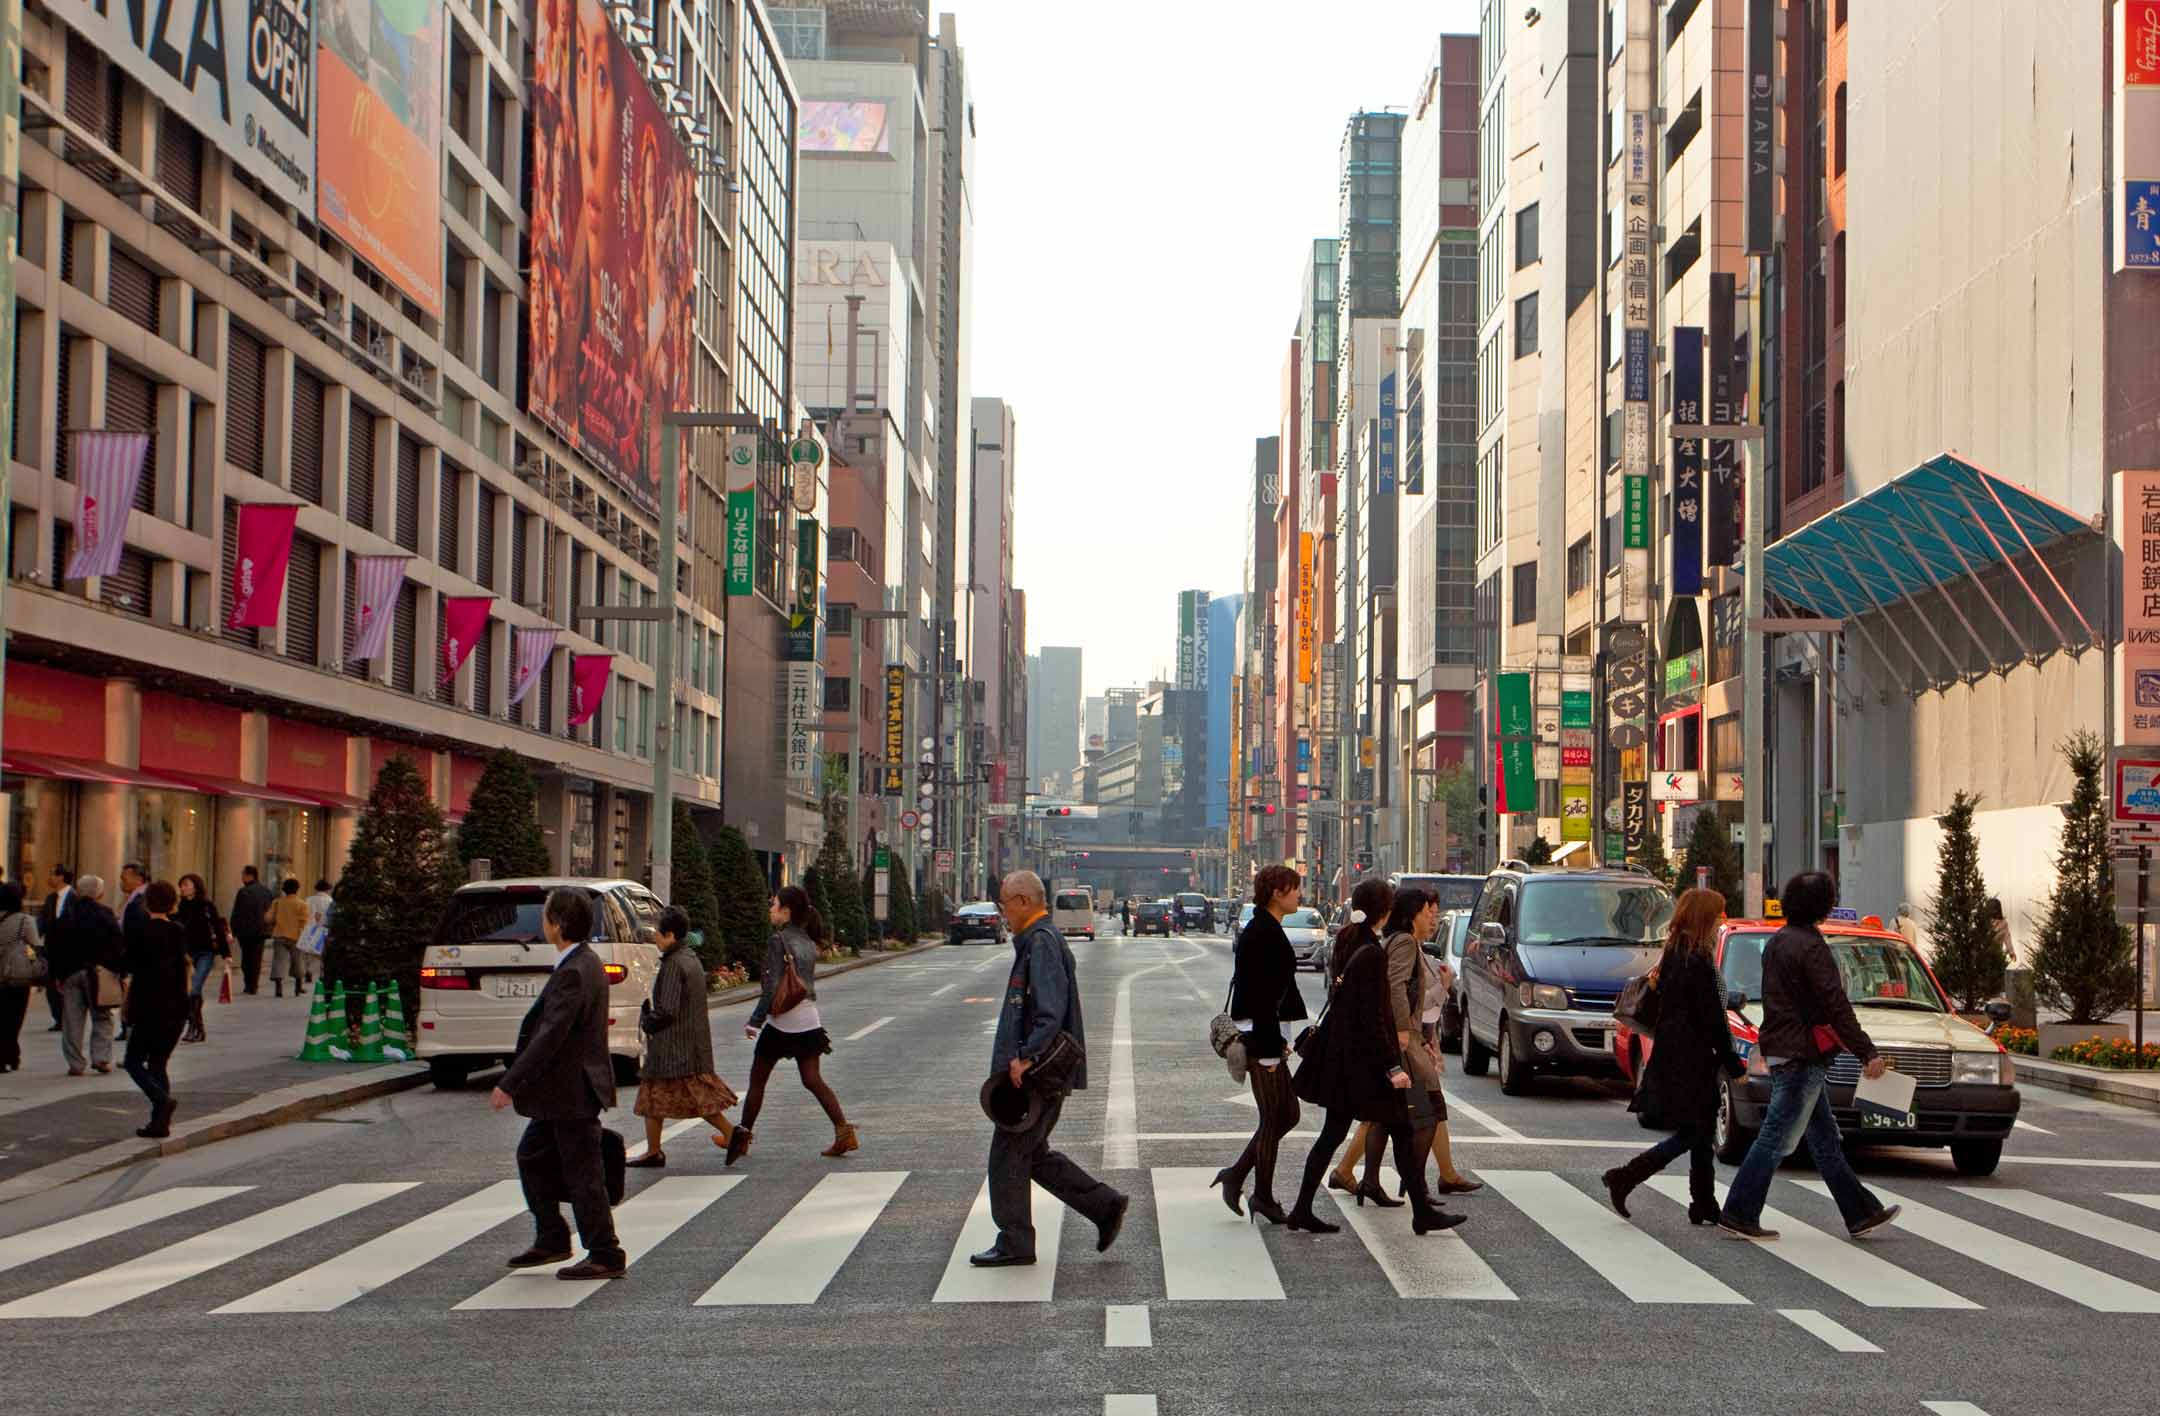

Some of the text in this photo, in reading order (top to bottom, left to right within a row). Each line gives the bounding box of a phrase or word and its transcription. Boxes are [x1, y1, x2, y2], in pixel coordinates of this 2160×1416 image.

[252, 16, 308, 121] OPEN
[1629, 215, 1647, 321] 企画通信社
[731, 506, 749, 584] りそな銀行
[791, 668, 809, 772] 三井住友銀行
[1627, 788, 1643, 852] タカゲン
